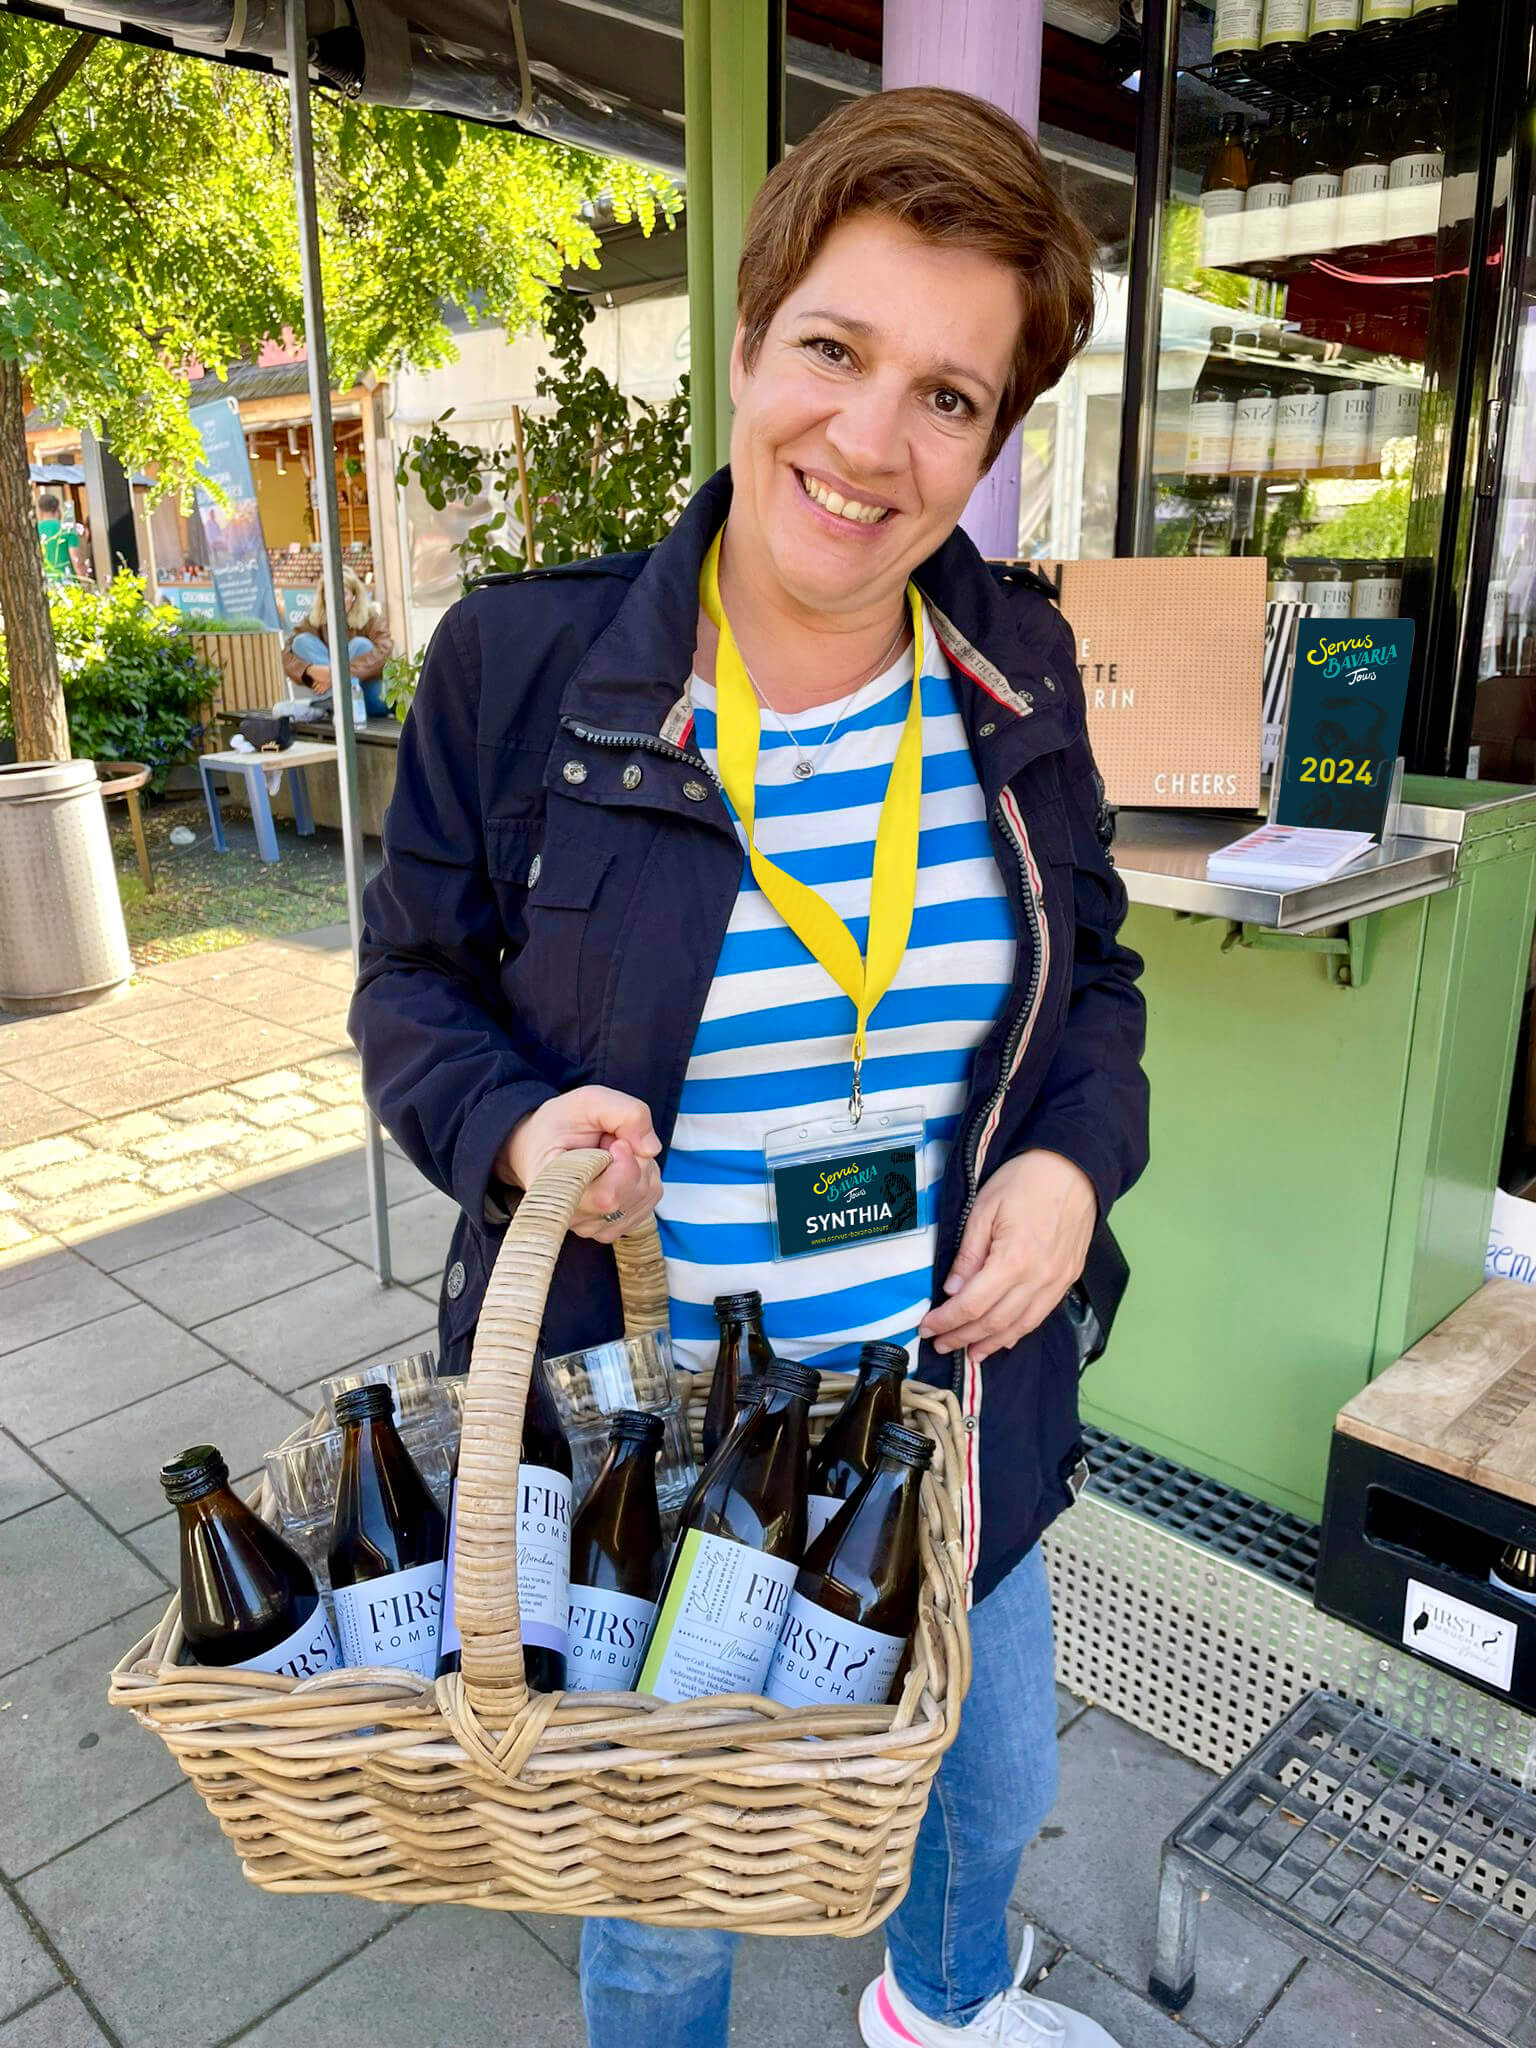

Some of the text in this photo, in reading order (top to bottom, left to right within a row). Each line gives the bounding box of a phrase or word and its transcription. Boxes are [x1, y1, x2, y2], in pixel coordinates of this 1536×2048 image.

[1307, 634, 1373, 665] Servus
[1322, 644, 1398, 678] BAVARIA
[1345, 667, 1377, 686] Tours
[1154, 772, 1237, 795] CHEERS
[1299, 756, 1373, 785] 2024
[813, 1162, 859, 1195] Servus
[827, 1164, 878, 1202] BAVARIA
[843, 1187, 866, 1203] Tours
[806, 1202, 893, 1234] SYNTHIA
[375, 1625, 436, 1652] KOMB
